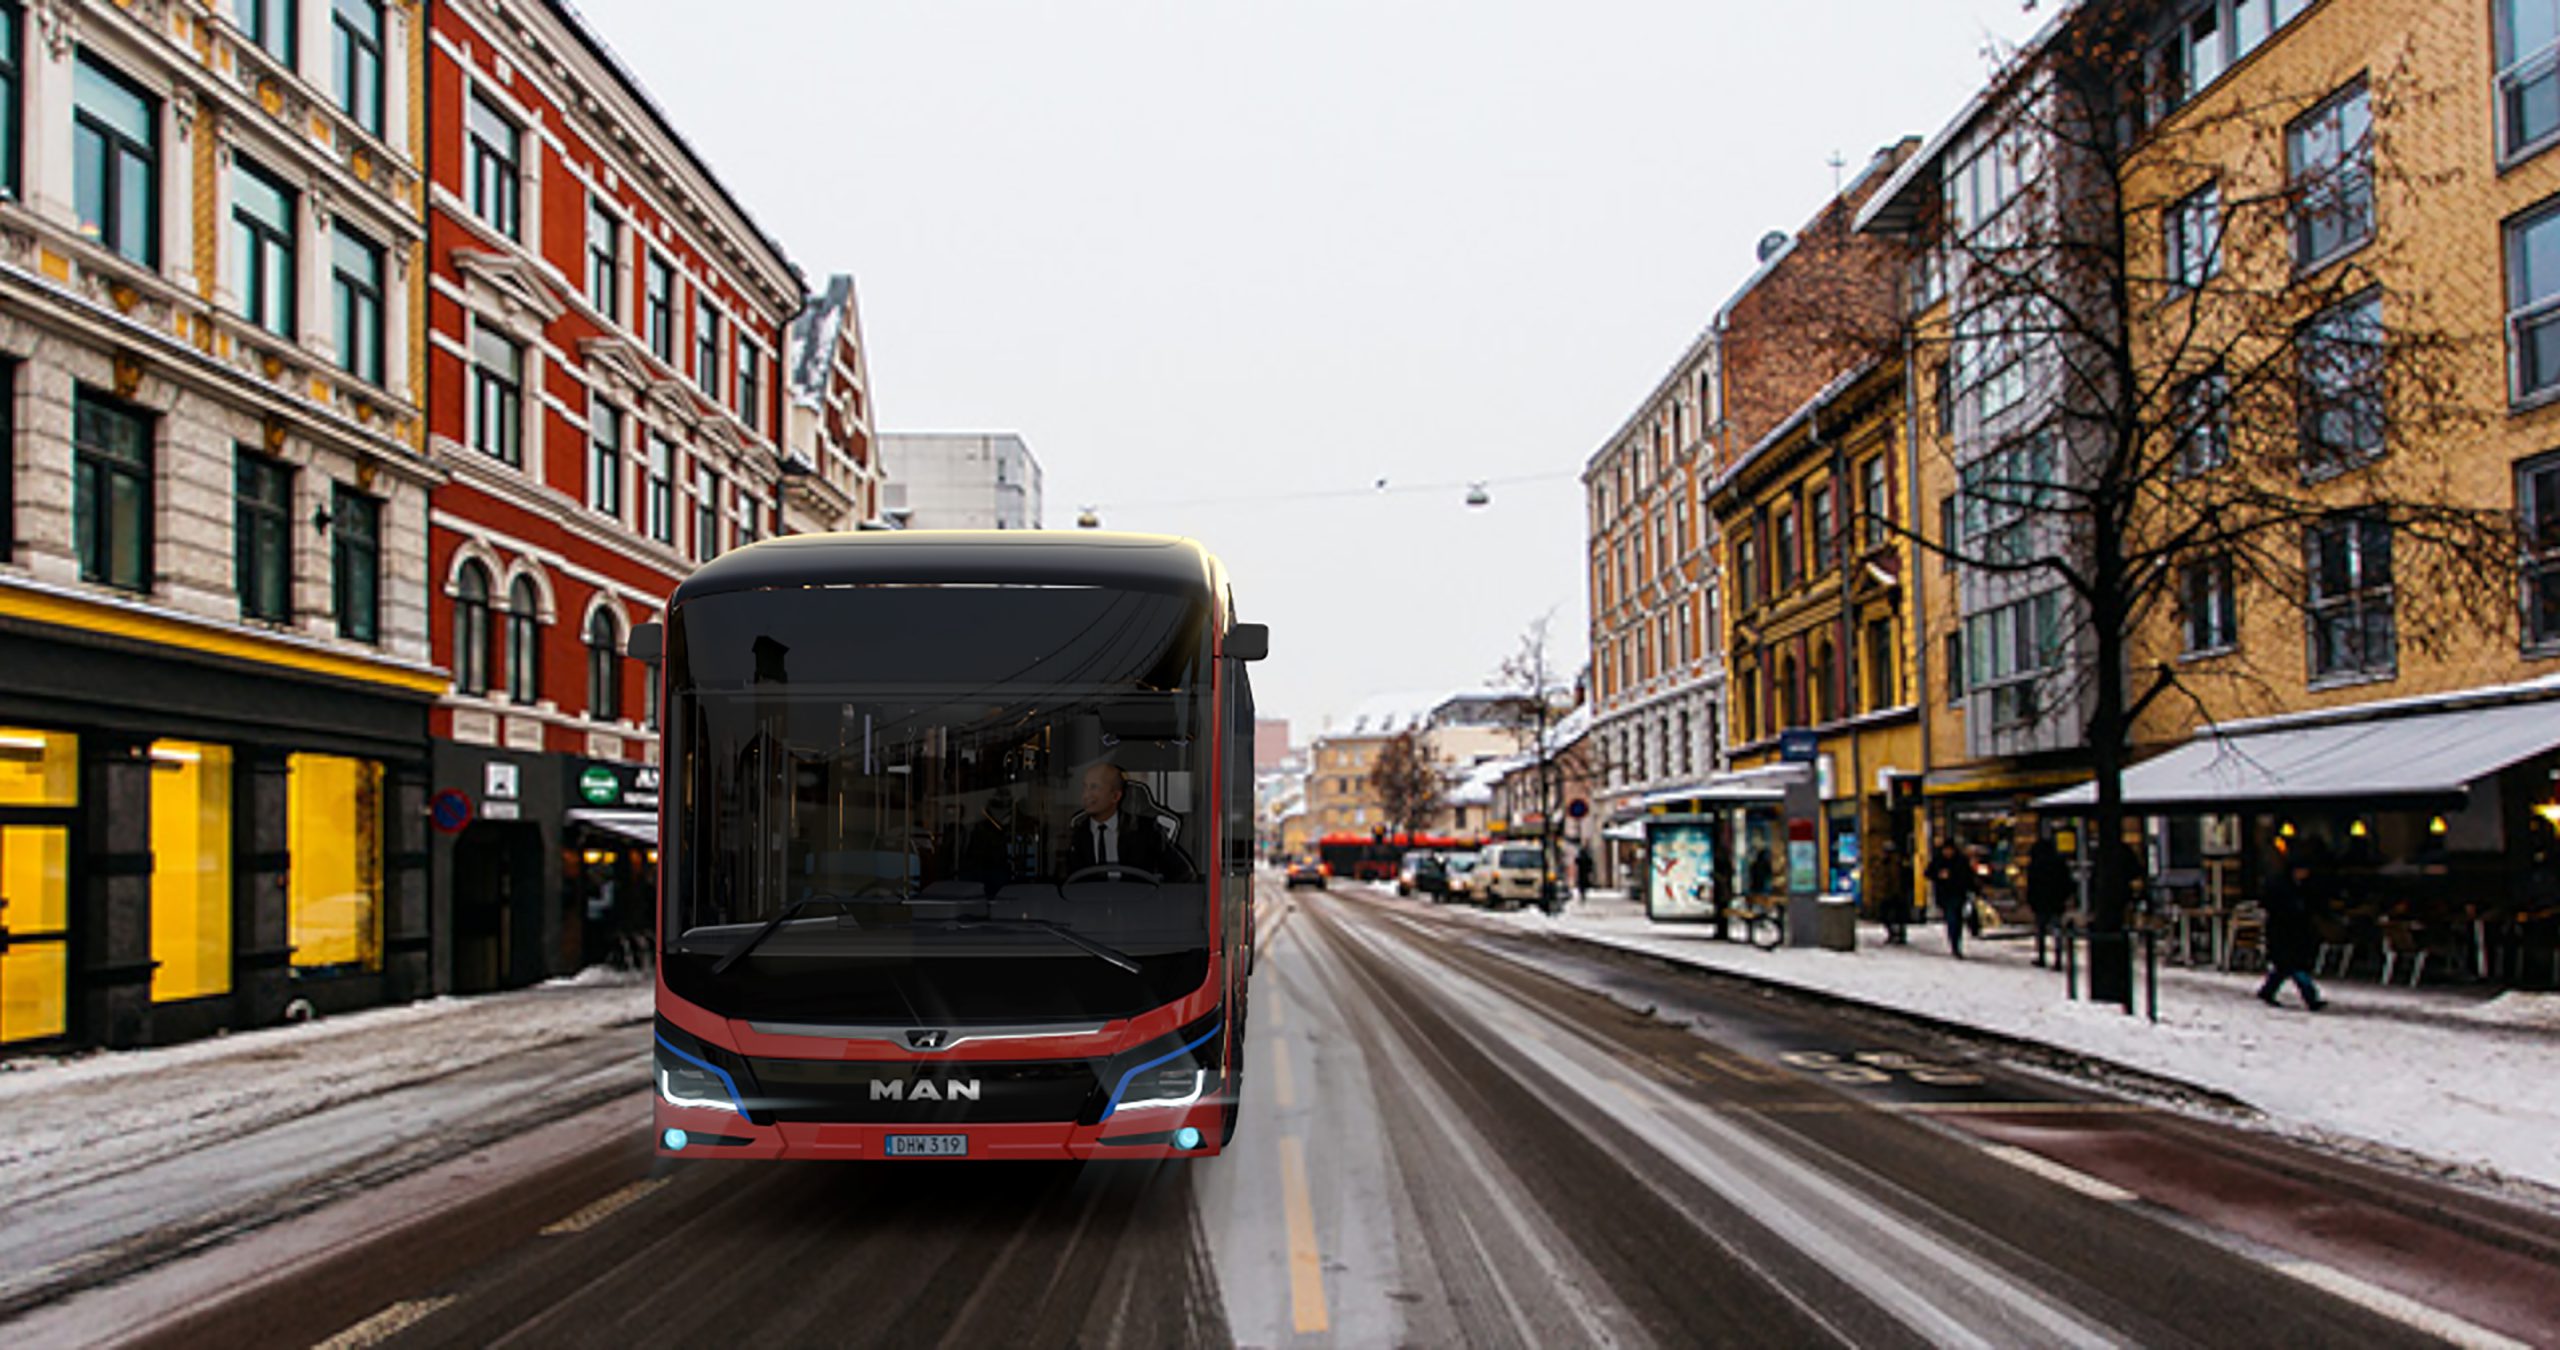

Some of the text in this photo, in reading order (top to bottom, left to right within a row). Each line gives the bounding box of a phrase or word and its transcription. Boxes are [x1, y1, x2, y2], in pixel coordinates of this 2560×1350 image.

[869, 1079, 981, 1100] MAN
[896, 1137, 960, 1153] DHW 319
